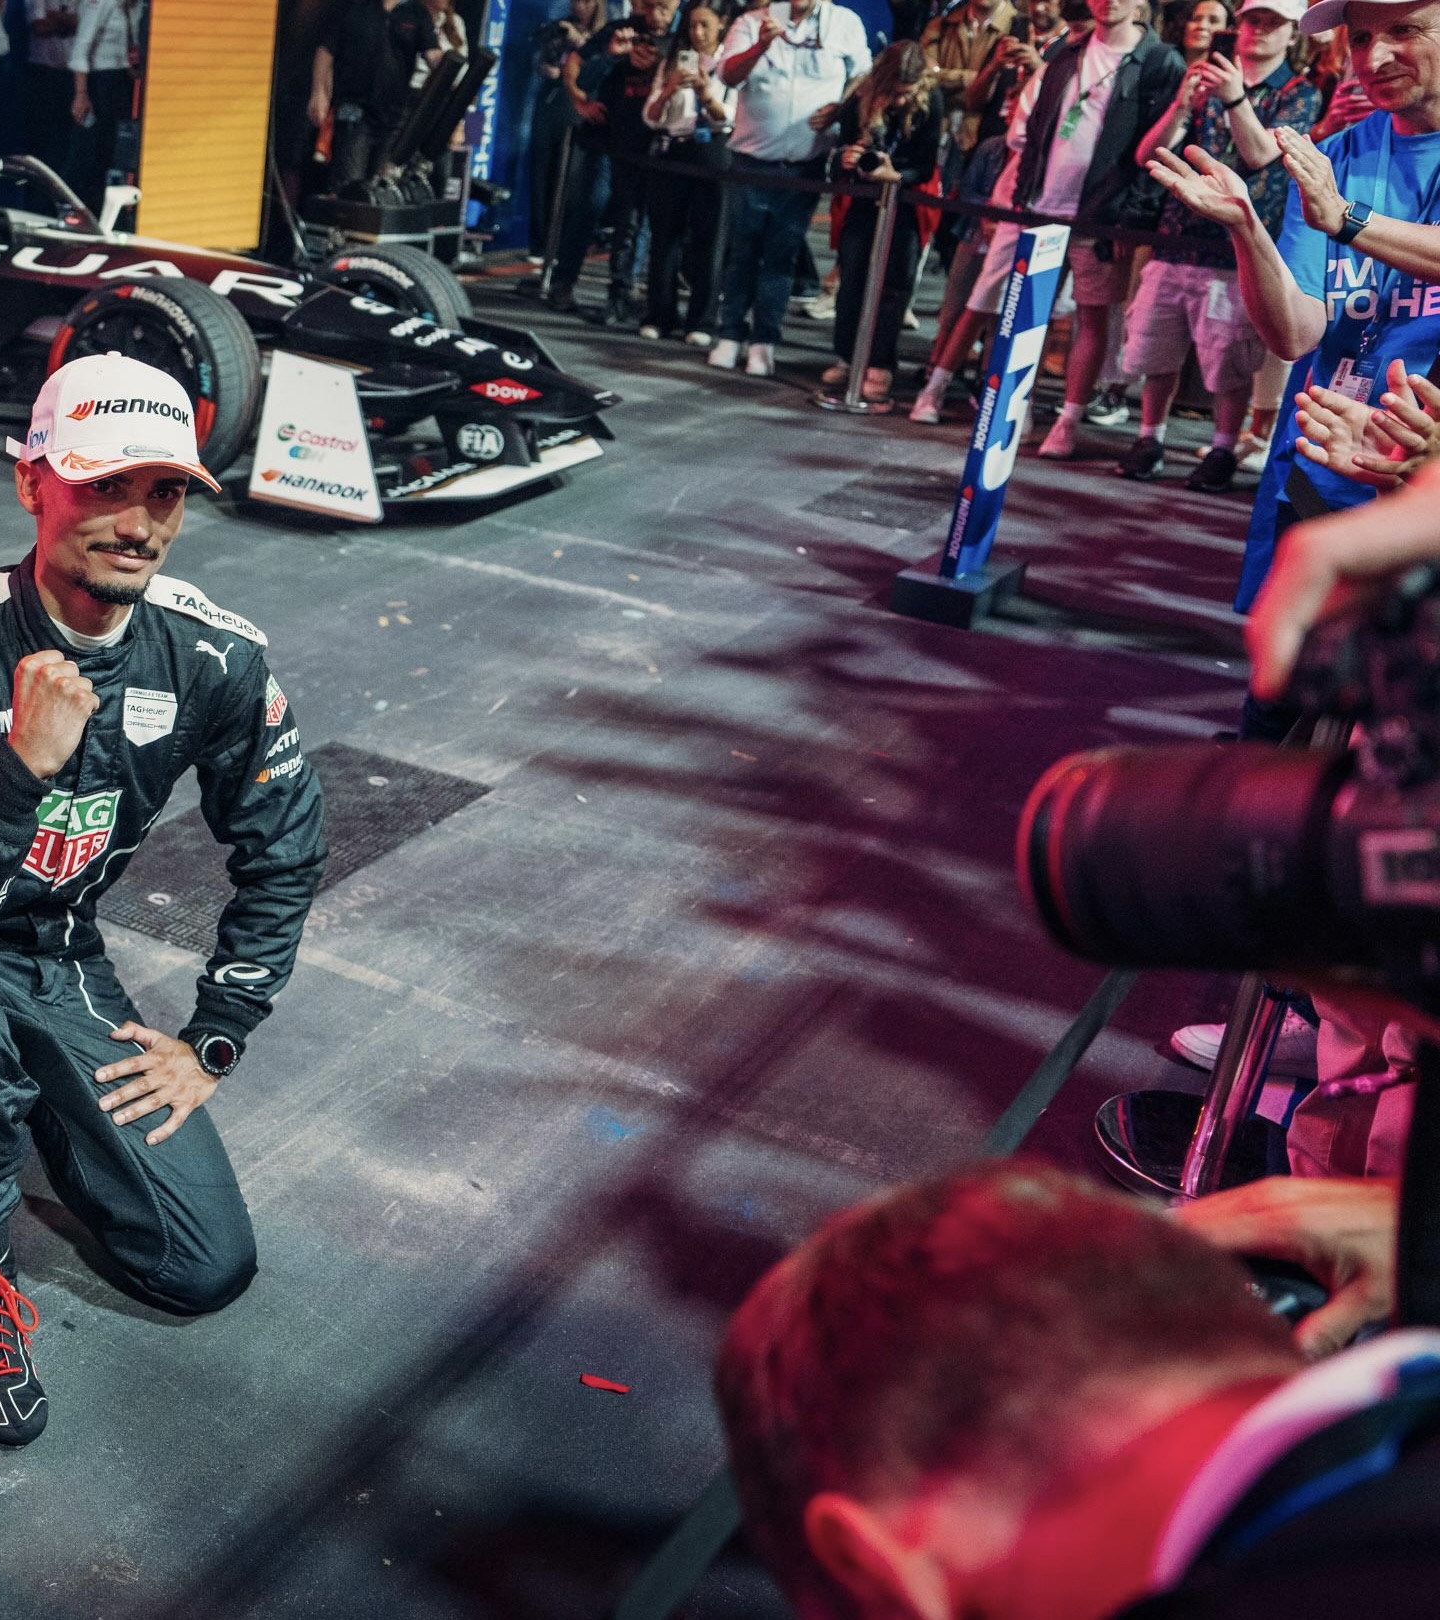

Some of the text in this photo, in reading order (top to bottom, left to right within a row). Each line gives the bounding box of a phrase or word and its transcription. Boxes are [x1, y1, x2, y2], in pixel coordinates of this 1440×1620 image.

[1327, 288, 1379, 321] TO
[982, 322, 1049, 492] 3
[299, 430, 360, 452] Castrol
